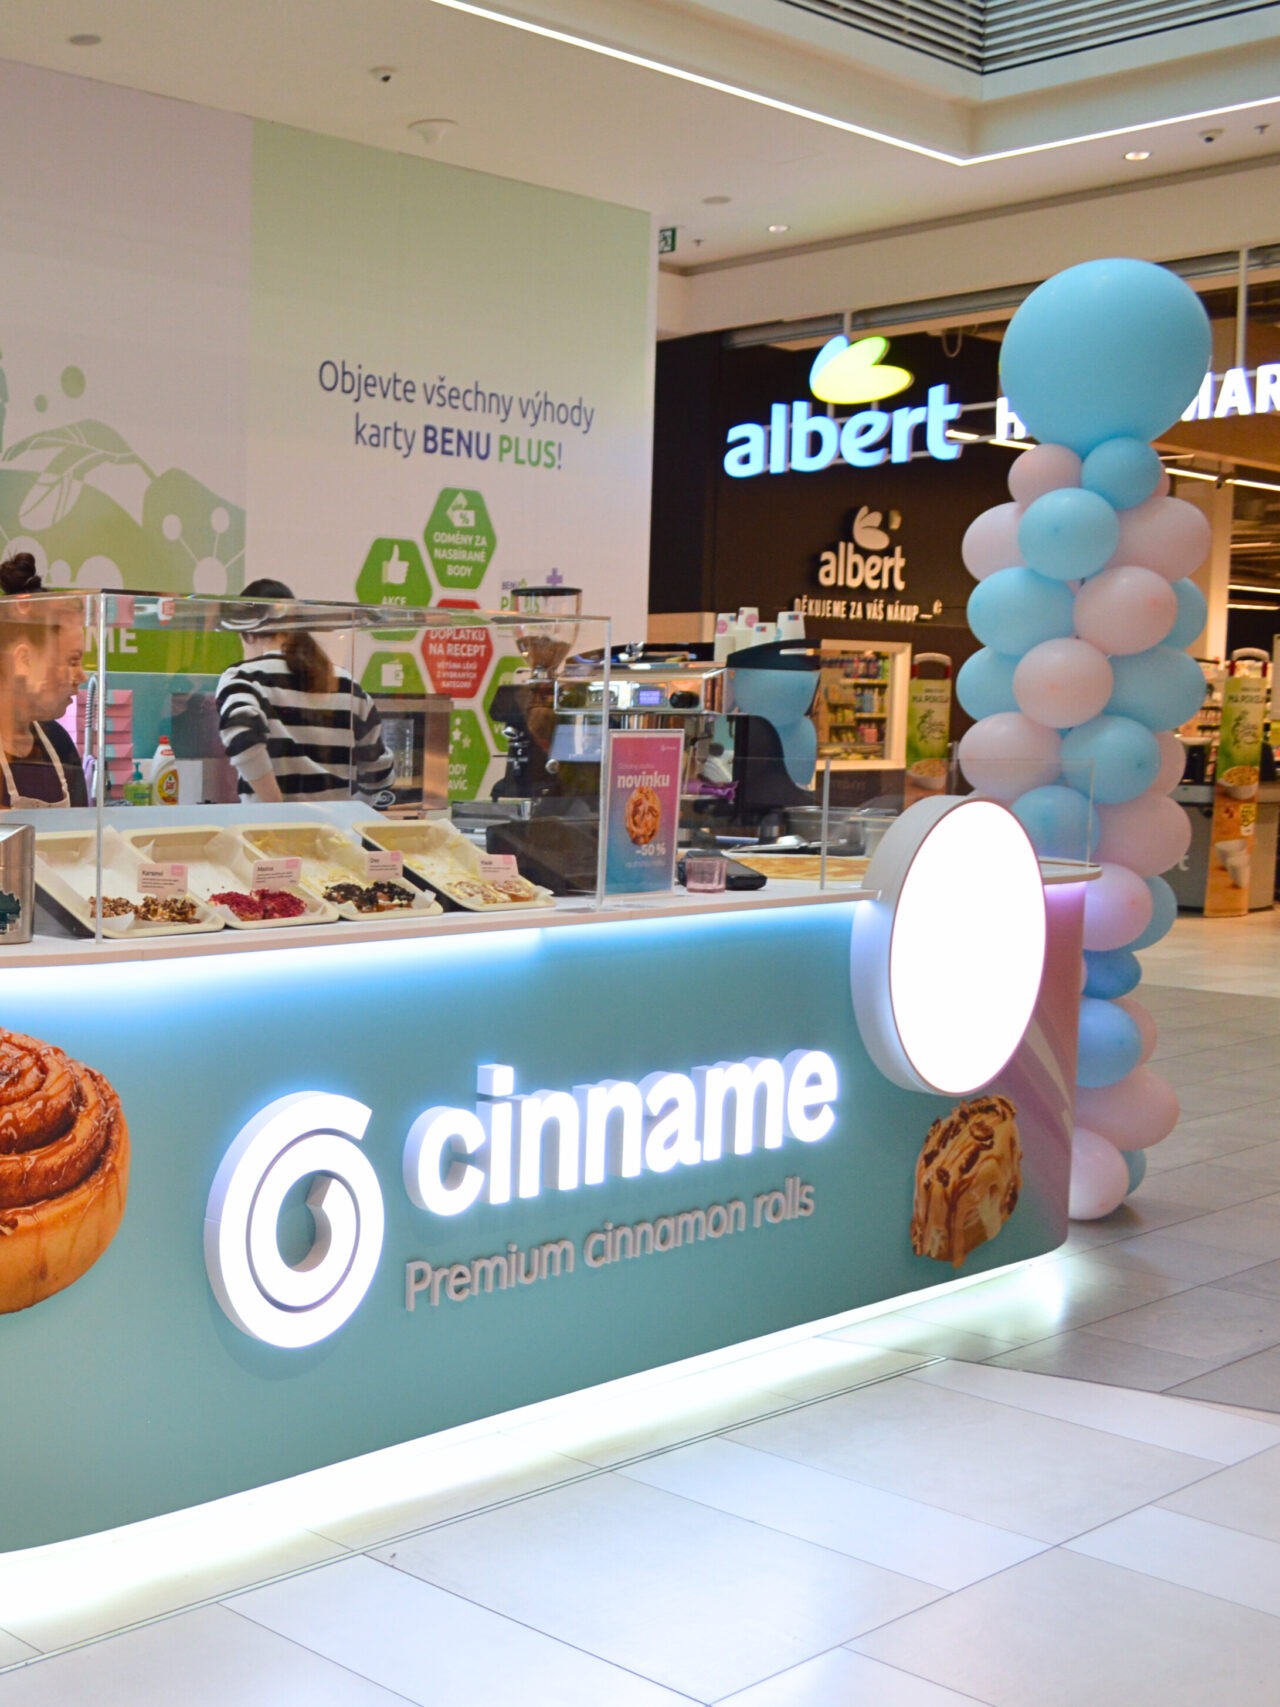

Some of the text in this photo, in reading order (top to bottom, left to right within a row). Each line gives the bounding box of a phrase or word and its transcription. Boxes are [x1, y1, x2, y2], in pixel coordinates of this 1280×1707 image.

[318, 360, 595, 434] Objevte všechny výhody
[723, 384, 961, 478] albert
[353, 412, 562, 470] karty BENU PLUS!
[433, 530, 488, 547] ODMĚNY ZA
[433, 547, 486, 563] NASBÍRANÉ
[447, 565, 472, 577] BODY
[818, 541, 906, 591] albert
[849, 601, 863, 619] ZA
[865, 599, 885, 620] VÁŠ
[886, 601, 920, 622] NÁKUP
[430, 628, 486, 642] DOPLATKU
[429, 643, 487, 657] NA RECEPT
[449, 764, 468, 775] ODY
[448, 777, 468, 790] AVÍC
[617, 771, 670, 788] novinku
[403, 1048, 838, 1216] cinname
[405, 1177, 816, 1311] Premium cinnamon rolls
